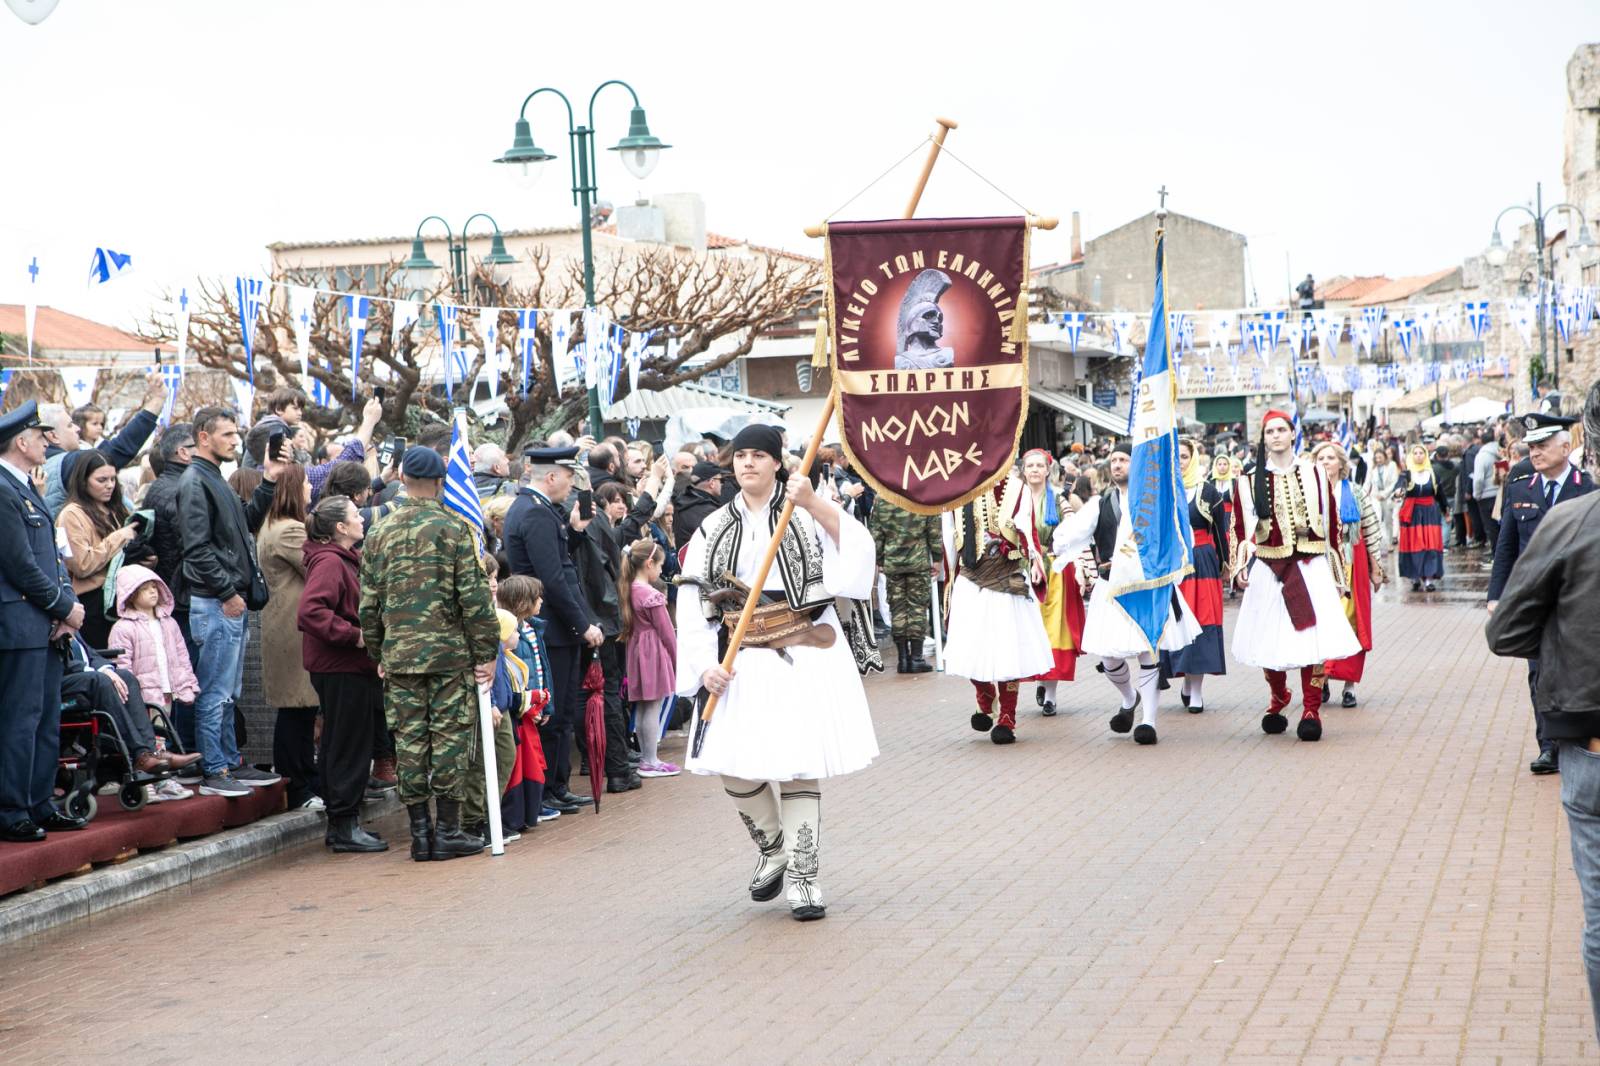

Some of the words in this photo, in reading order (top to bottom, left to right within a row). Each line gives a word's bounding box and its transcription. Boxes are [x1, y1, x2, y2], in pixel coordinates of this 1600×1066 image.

[841, 279, 878, 362] ΛΥΚΕΙΟ
[879, 250, 925, 279] ΤΩΝ
[870, 369, 990, 393] ΣΠΑΡΤΗΣ
[861, 401, 970, 450] ΜΟΛΩΝ
[902, 442, 983, 490] ΛΑΒΕ
